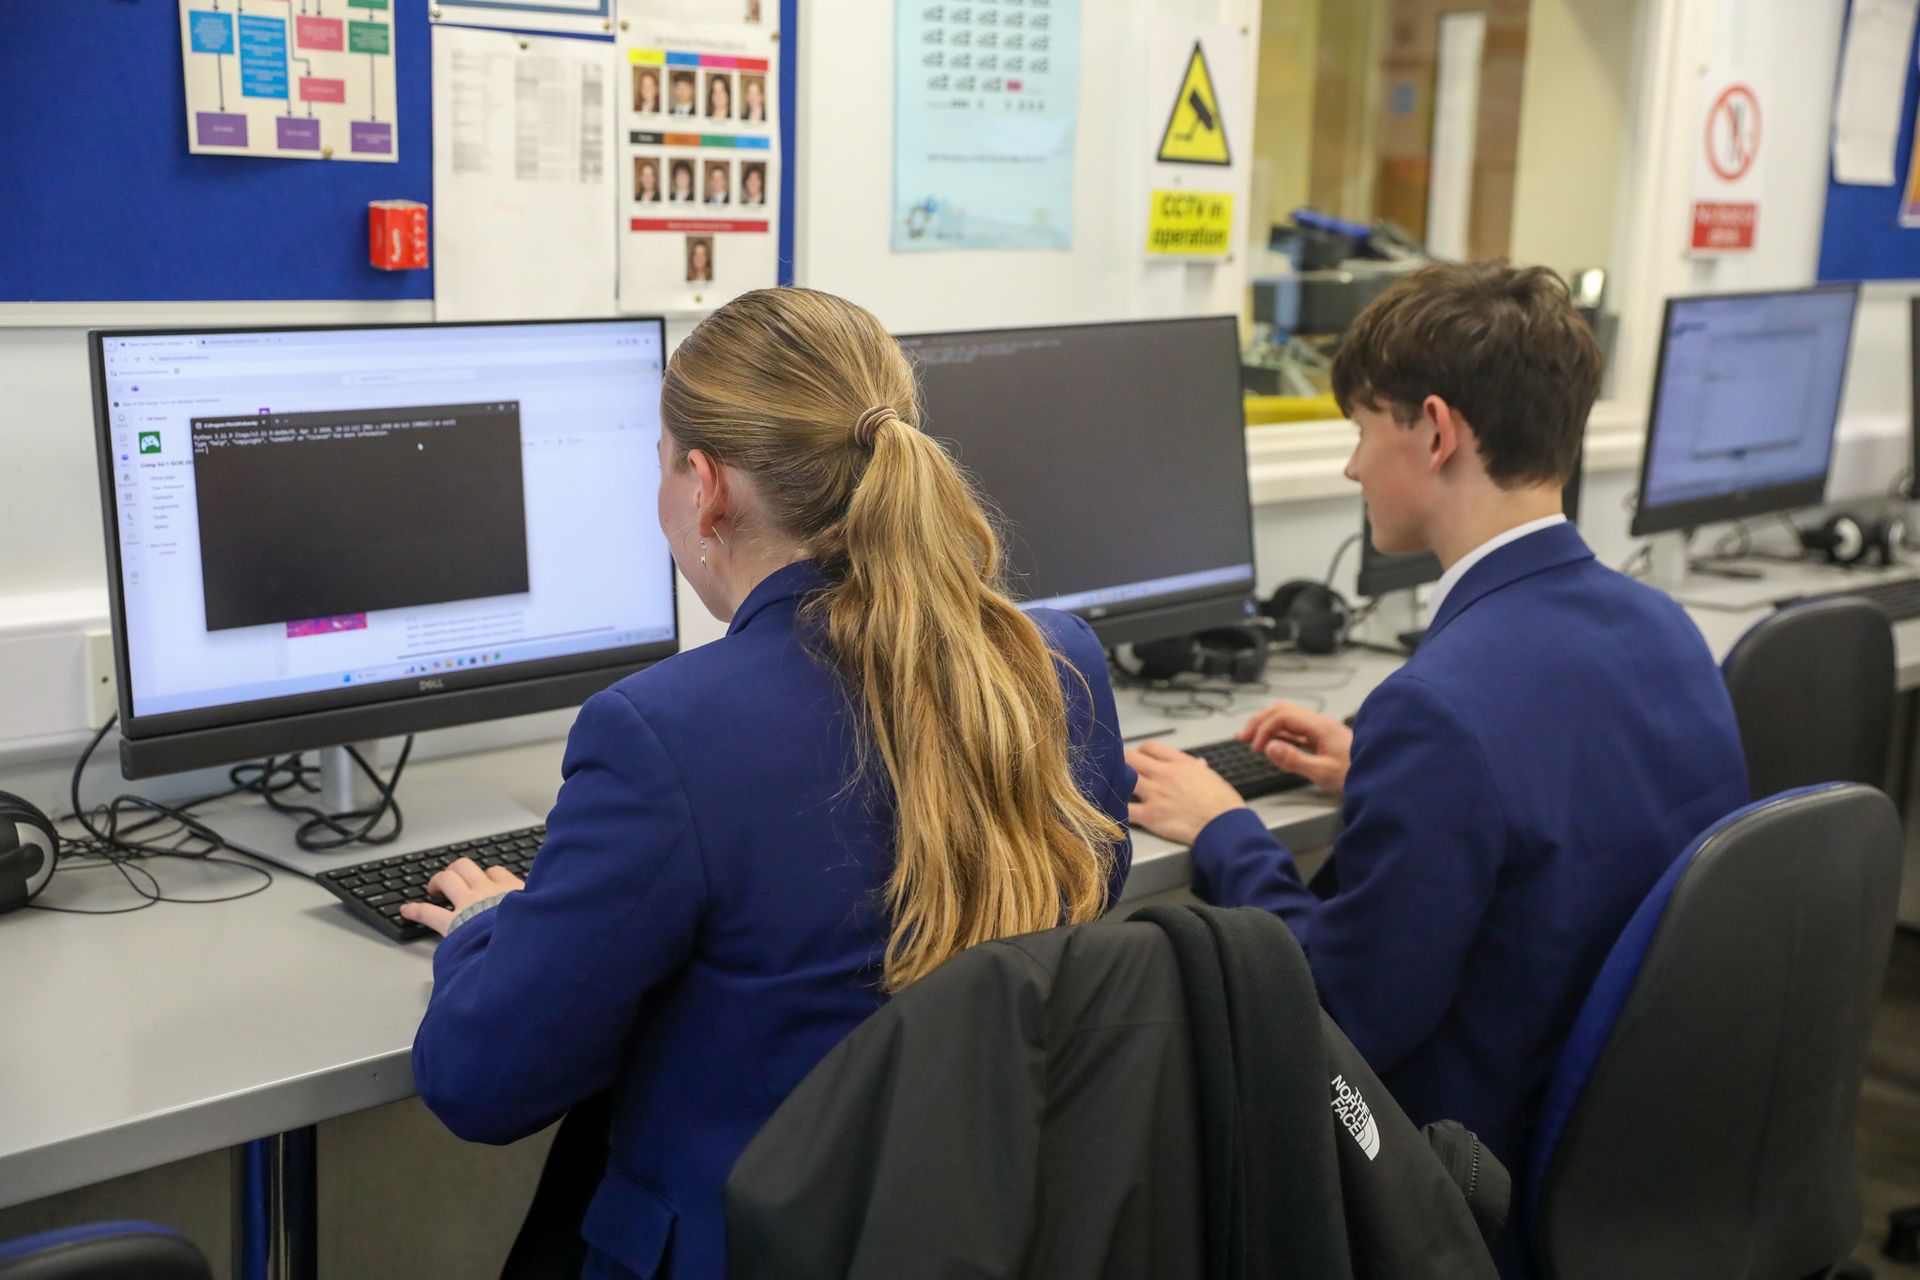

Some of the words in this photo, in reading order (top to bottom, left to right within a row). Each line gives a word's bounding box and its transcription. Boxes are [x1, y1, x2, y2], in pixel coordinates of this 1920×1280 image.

[1160, 193, 1204, 217] CCTV
[1211, 201, 1225, 217] in
[1153, 227, 1226, 248] operation
[419, 678, 444, 691] DELL
[1331, 1074, 1369, 1127] NORTH
[1355, 1086, 1371, 1117] THE
[1331, 1097, 1363, 1136] FACE
